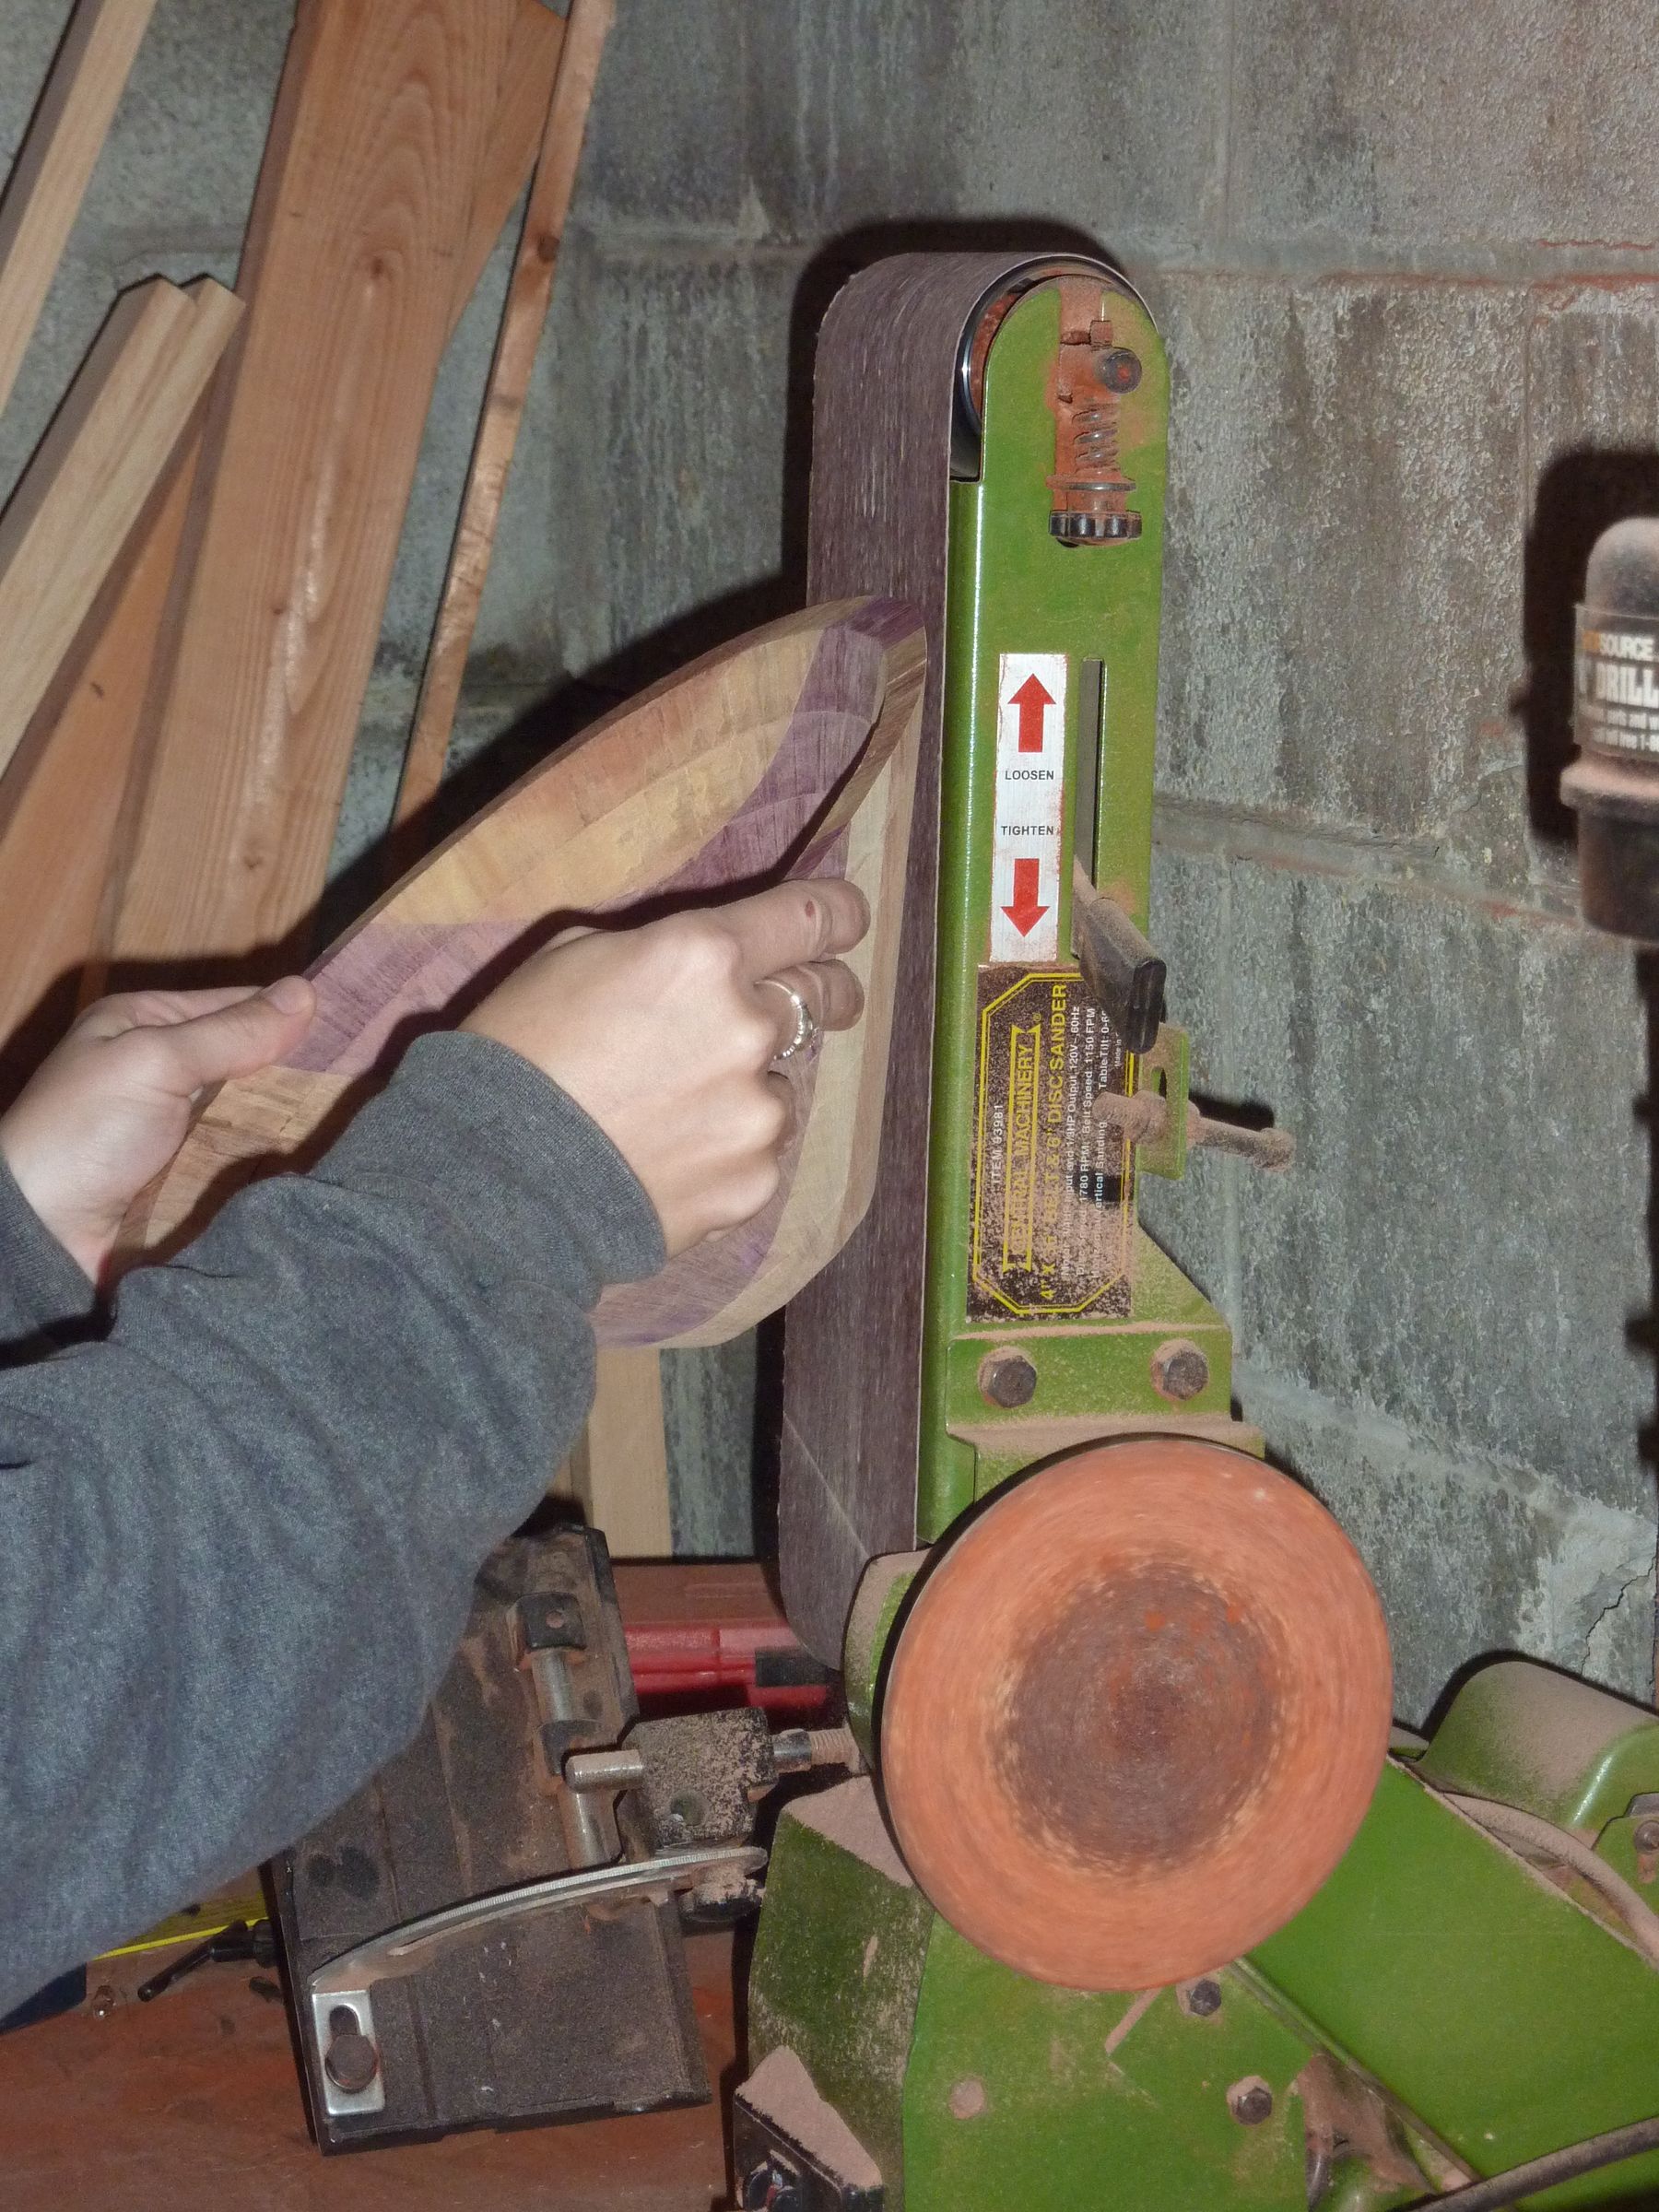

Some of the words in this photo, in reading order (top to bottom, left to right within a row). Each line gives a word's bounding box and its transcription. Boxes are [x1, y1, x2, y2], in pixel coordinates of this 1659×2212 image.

[1596, 661, 1659, 708] DRILL
[1005, 770, 1054, 781] LOOSEN
[1001, 825, 1054, 836] TIGHTEN
[1049, 984, 1067, 1069] SANDER
[1086, 1007, 1095, 1033] FPM
[1084, 1036, 1095, 1064] 1150
[1015, 1043, 1032, 1156] MACHINERY
[1047, 1076, 1064, 1123] DISC
[1083, 1067, 1093, 1107] Speed:
[992, 1105, 1003, 1144] 93981
[1082, 1111, 1091, 1134] Belt
[1047, 1128, 1062, 1147] 6"
[1095, 1122, 1107, 1169] Sanding
[991, 1150, 1003, 1183] ITEM
[1045, 1153, 1060, 1166] &
[1065, 1150, 1075, 1171] and
[1079, 1175, 1088, 1202] 1780
[1040, 1279, 1056, 1299] 4"
